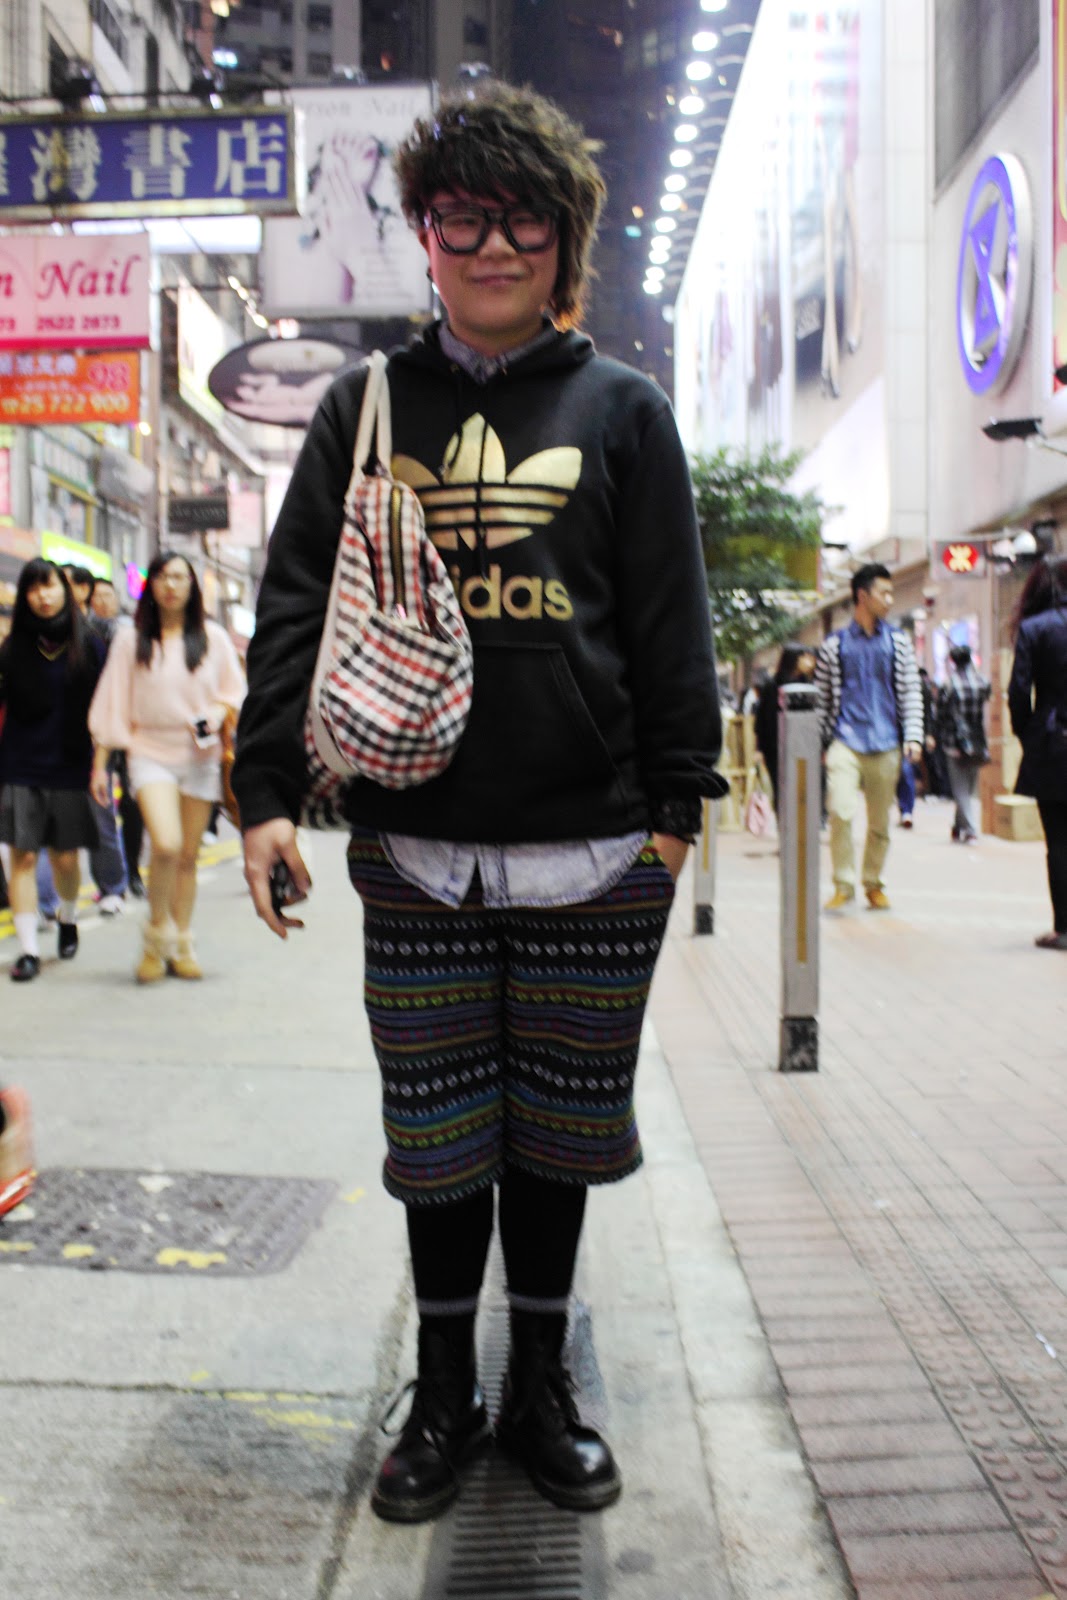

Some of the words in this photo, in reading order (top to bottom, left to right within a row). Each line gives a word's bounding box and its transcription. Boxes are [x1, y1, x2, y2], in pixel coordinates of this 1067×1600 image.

[0, 120, 284, 200] 灣書店
[35, 253, 142, 300] Nail
